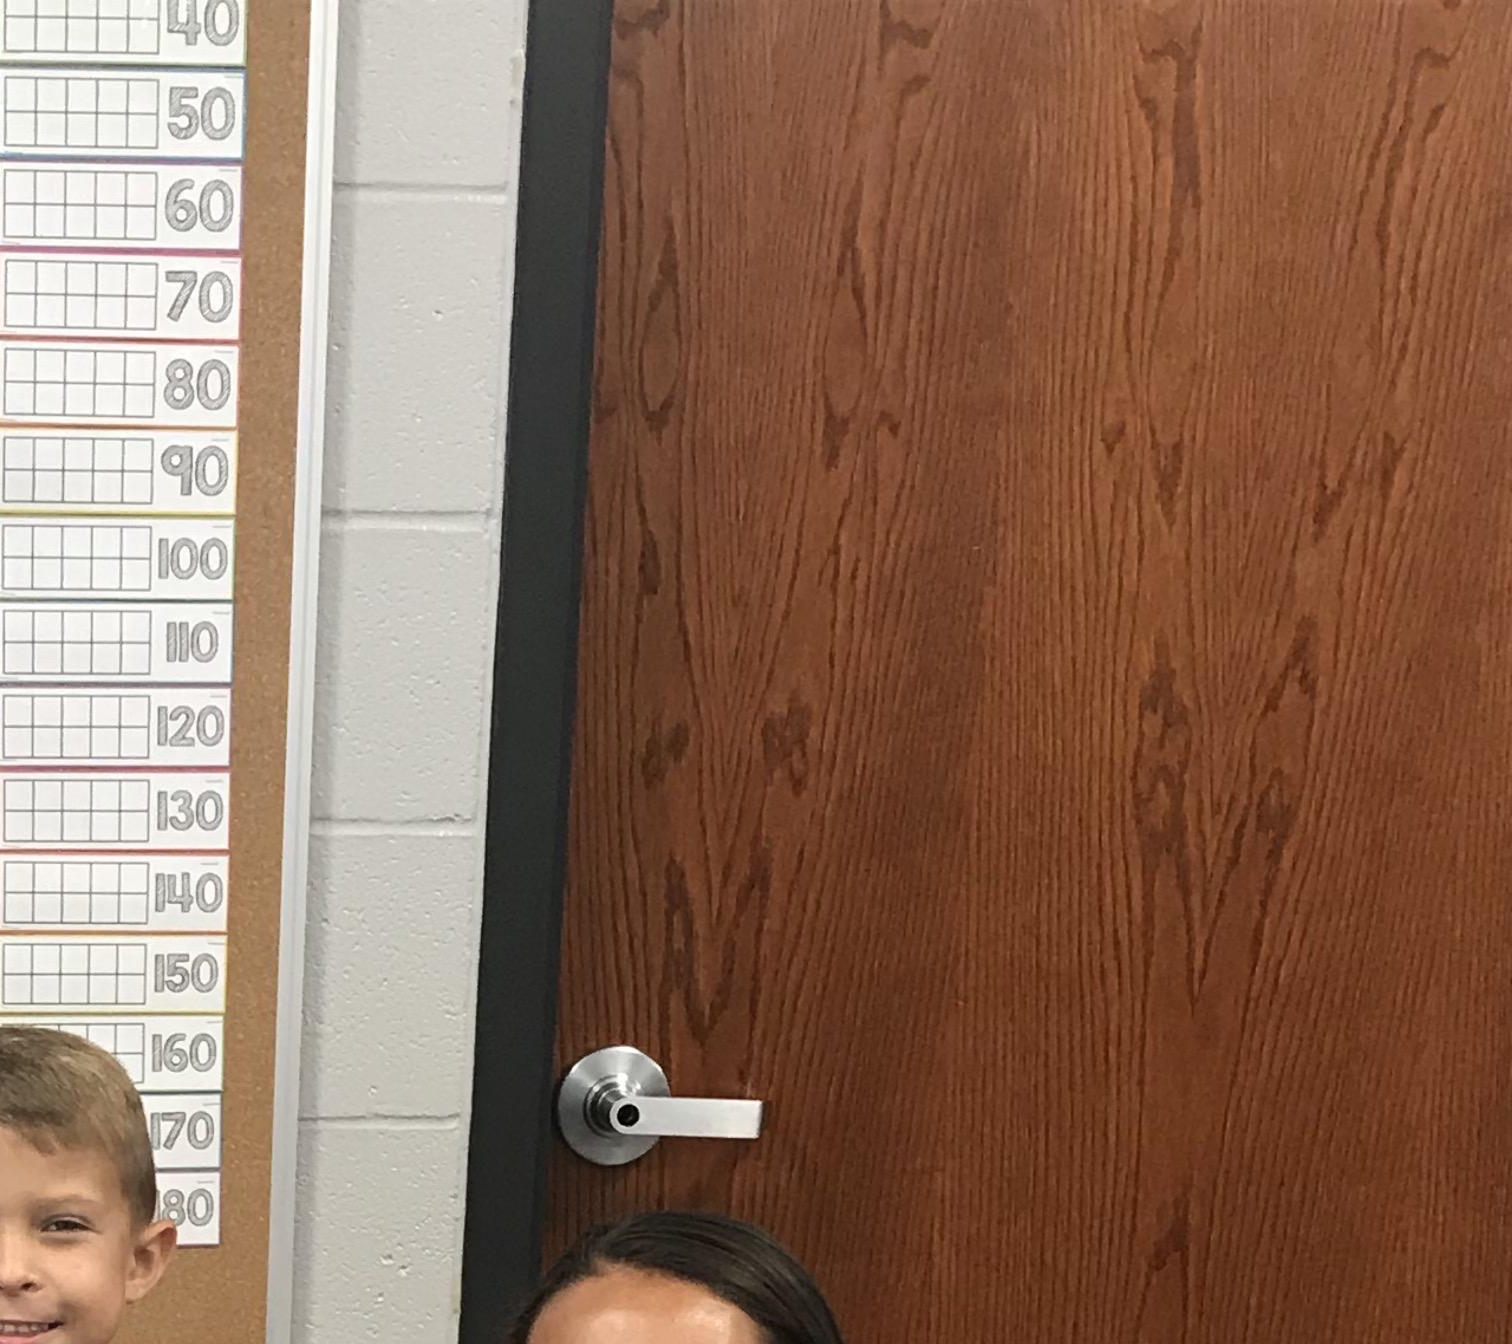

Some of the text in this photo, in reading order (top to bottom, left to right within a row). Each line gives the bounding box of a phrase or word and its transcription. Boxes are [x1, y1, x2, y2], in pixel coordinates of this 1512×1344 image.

[166, 0, 239, 46] 40
[167, 86, 236, 140] 50
[164, 178, 235, 232] 60
[164, 270, 234, 323] 70
[163, 358, 231, 410] 80
[161, 445, 229, 497] 90
[158, 537, 228, 581] 100
[166, 621, 219, 664] 110
[157, 705, 224, 747] 120
[157, 790, 224, 831] 130
[155, 871, 223, 914] 140
[154, 953, 219, 994] 150
[151, 1032, 217, 1073] 160
[150, 1110, 215, 1150] 170
